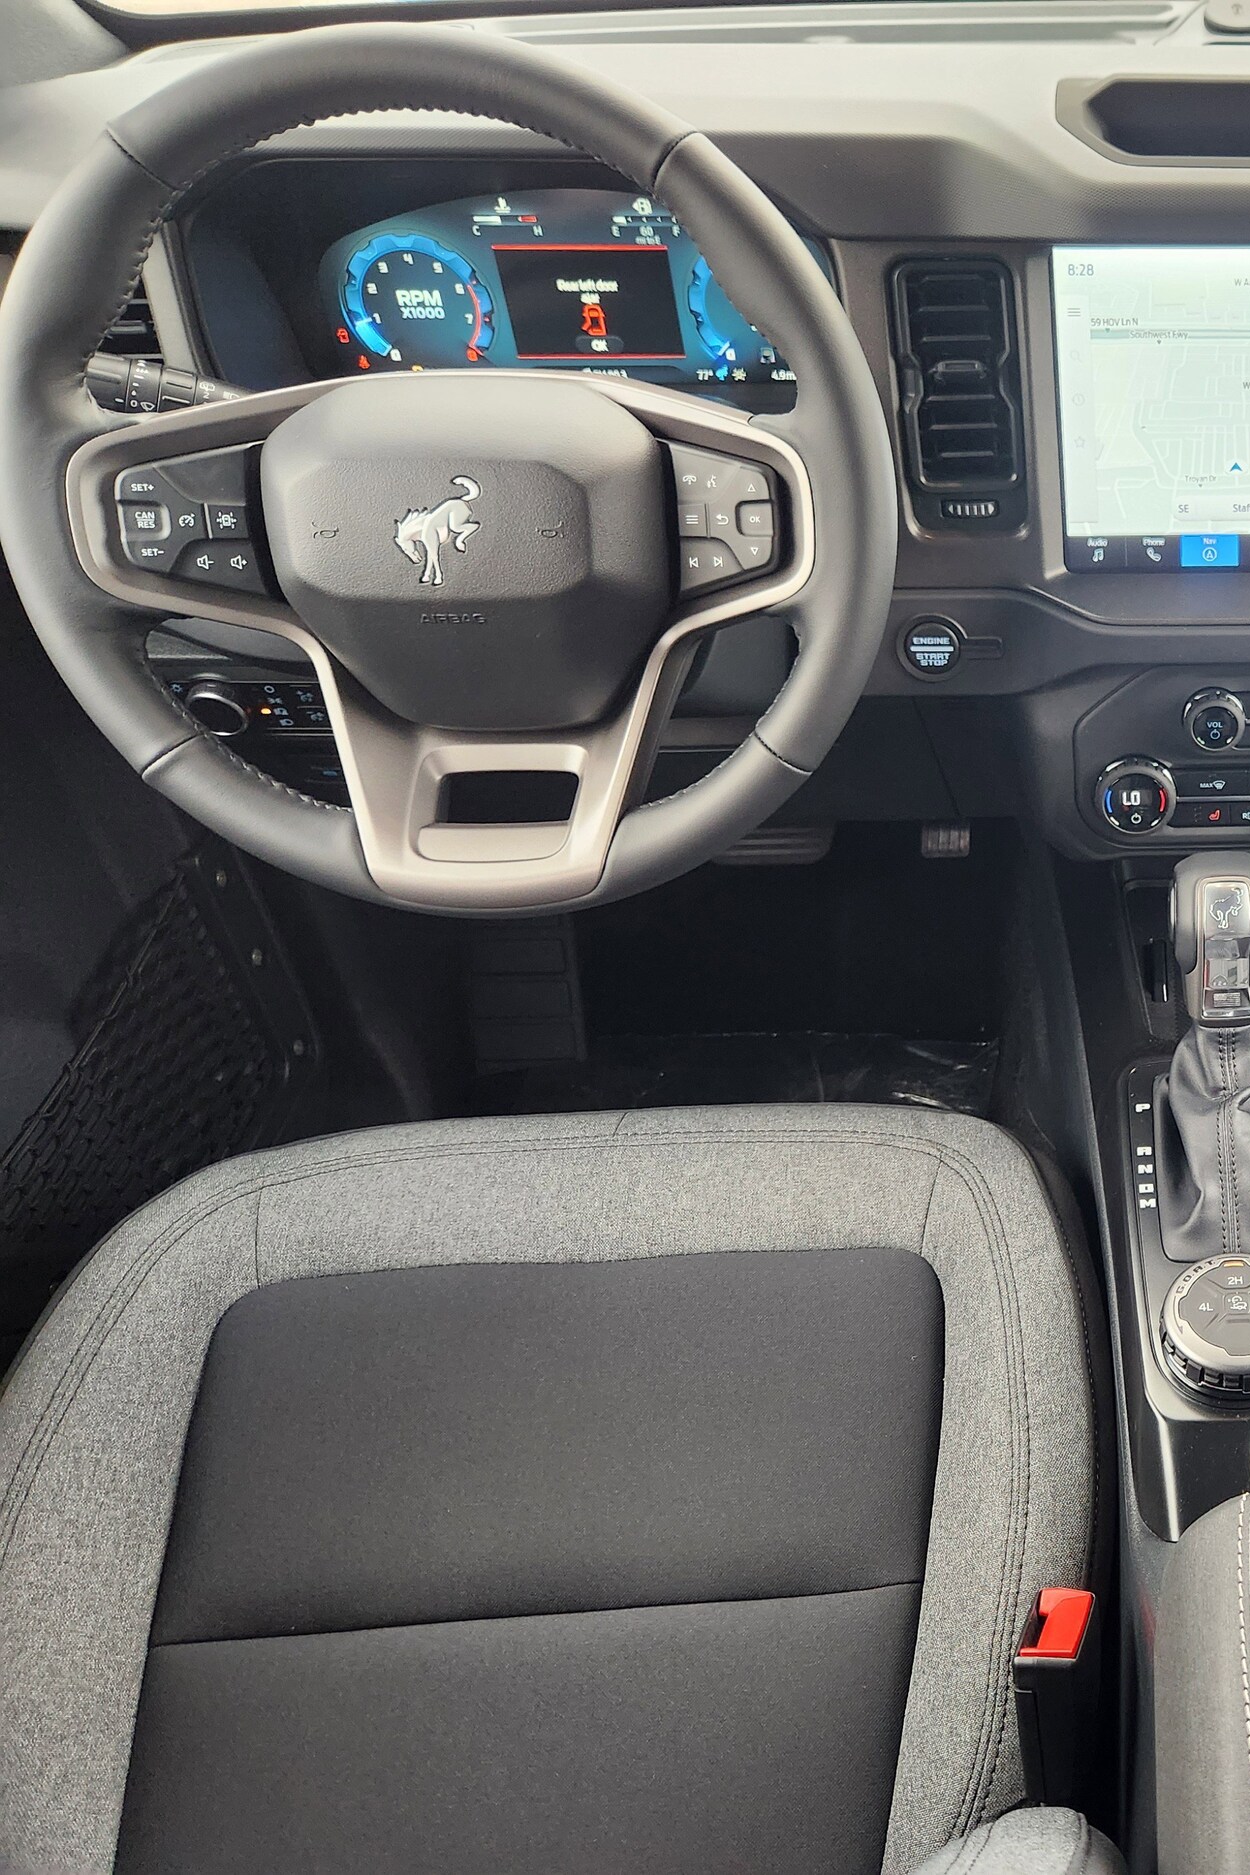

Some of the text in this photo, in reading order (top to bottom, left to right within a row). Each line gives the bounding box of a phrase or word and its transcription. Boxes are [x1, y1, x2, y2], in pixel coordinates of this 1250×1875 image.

[533, 225, 543, 237] H
[403, 253, 414, 265] 4
[378, 262, 389, 273] 3
[433, 262, 443, 273] 5
[1067, 263, 1094, 276] 8:28
[367, 283, 378, 294] 2
[395, 290, 443, 307] RPM
[373, 313, 382, 324] 1
[464, 313, 473, 325] 7
[1090, 318, 1101, 327] 59
[1103, 318, 1120, 327] HOV
[1131, 318, 1139, 326] N
[1130, 330, 1171, 339] Southwest
[1243, 381, 1250, 390] W
[131, 483, 154, 492] SET+
[1178, 504, 1190, 513] SE
[134, 511, 155, 520] CAN
[137, 521, 156, 529] RES
[1087, 537, 1108, 547] Audio
[1142, 537, 1166, 547] Phone
[1203, 537, 1217, 545] Nav
[420, 613, 487, 624] AIRBAG
[912, 637, 950, 645] ENGINE
[1207, 721, 1223, 729] VOL
[1122, 790, 1141, 806] LO
[1135, 1103, 1150, 1112] P
[1136, 1146, 1152, 1156] R
[1138, 1164, 1153, 1174] N
[1138, 1184, 1154, 1194] D
[1139, 1198, 1157, 1209] M
[1227, 1276, 1243, 1285] 2H
[1198, 1302, 1213, 1311] 4L
